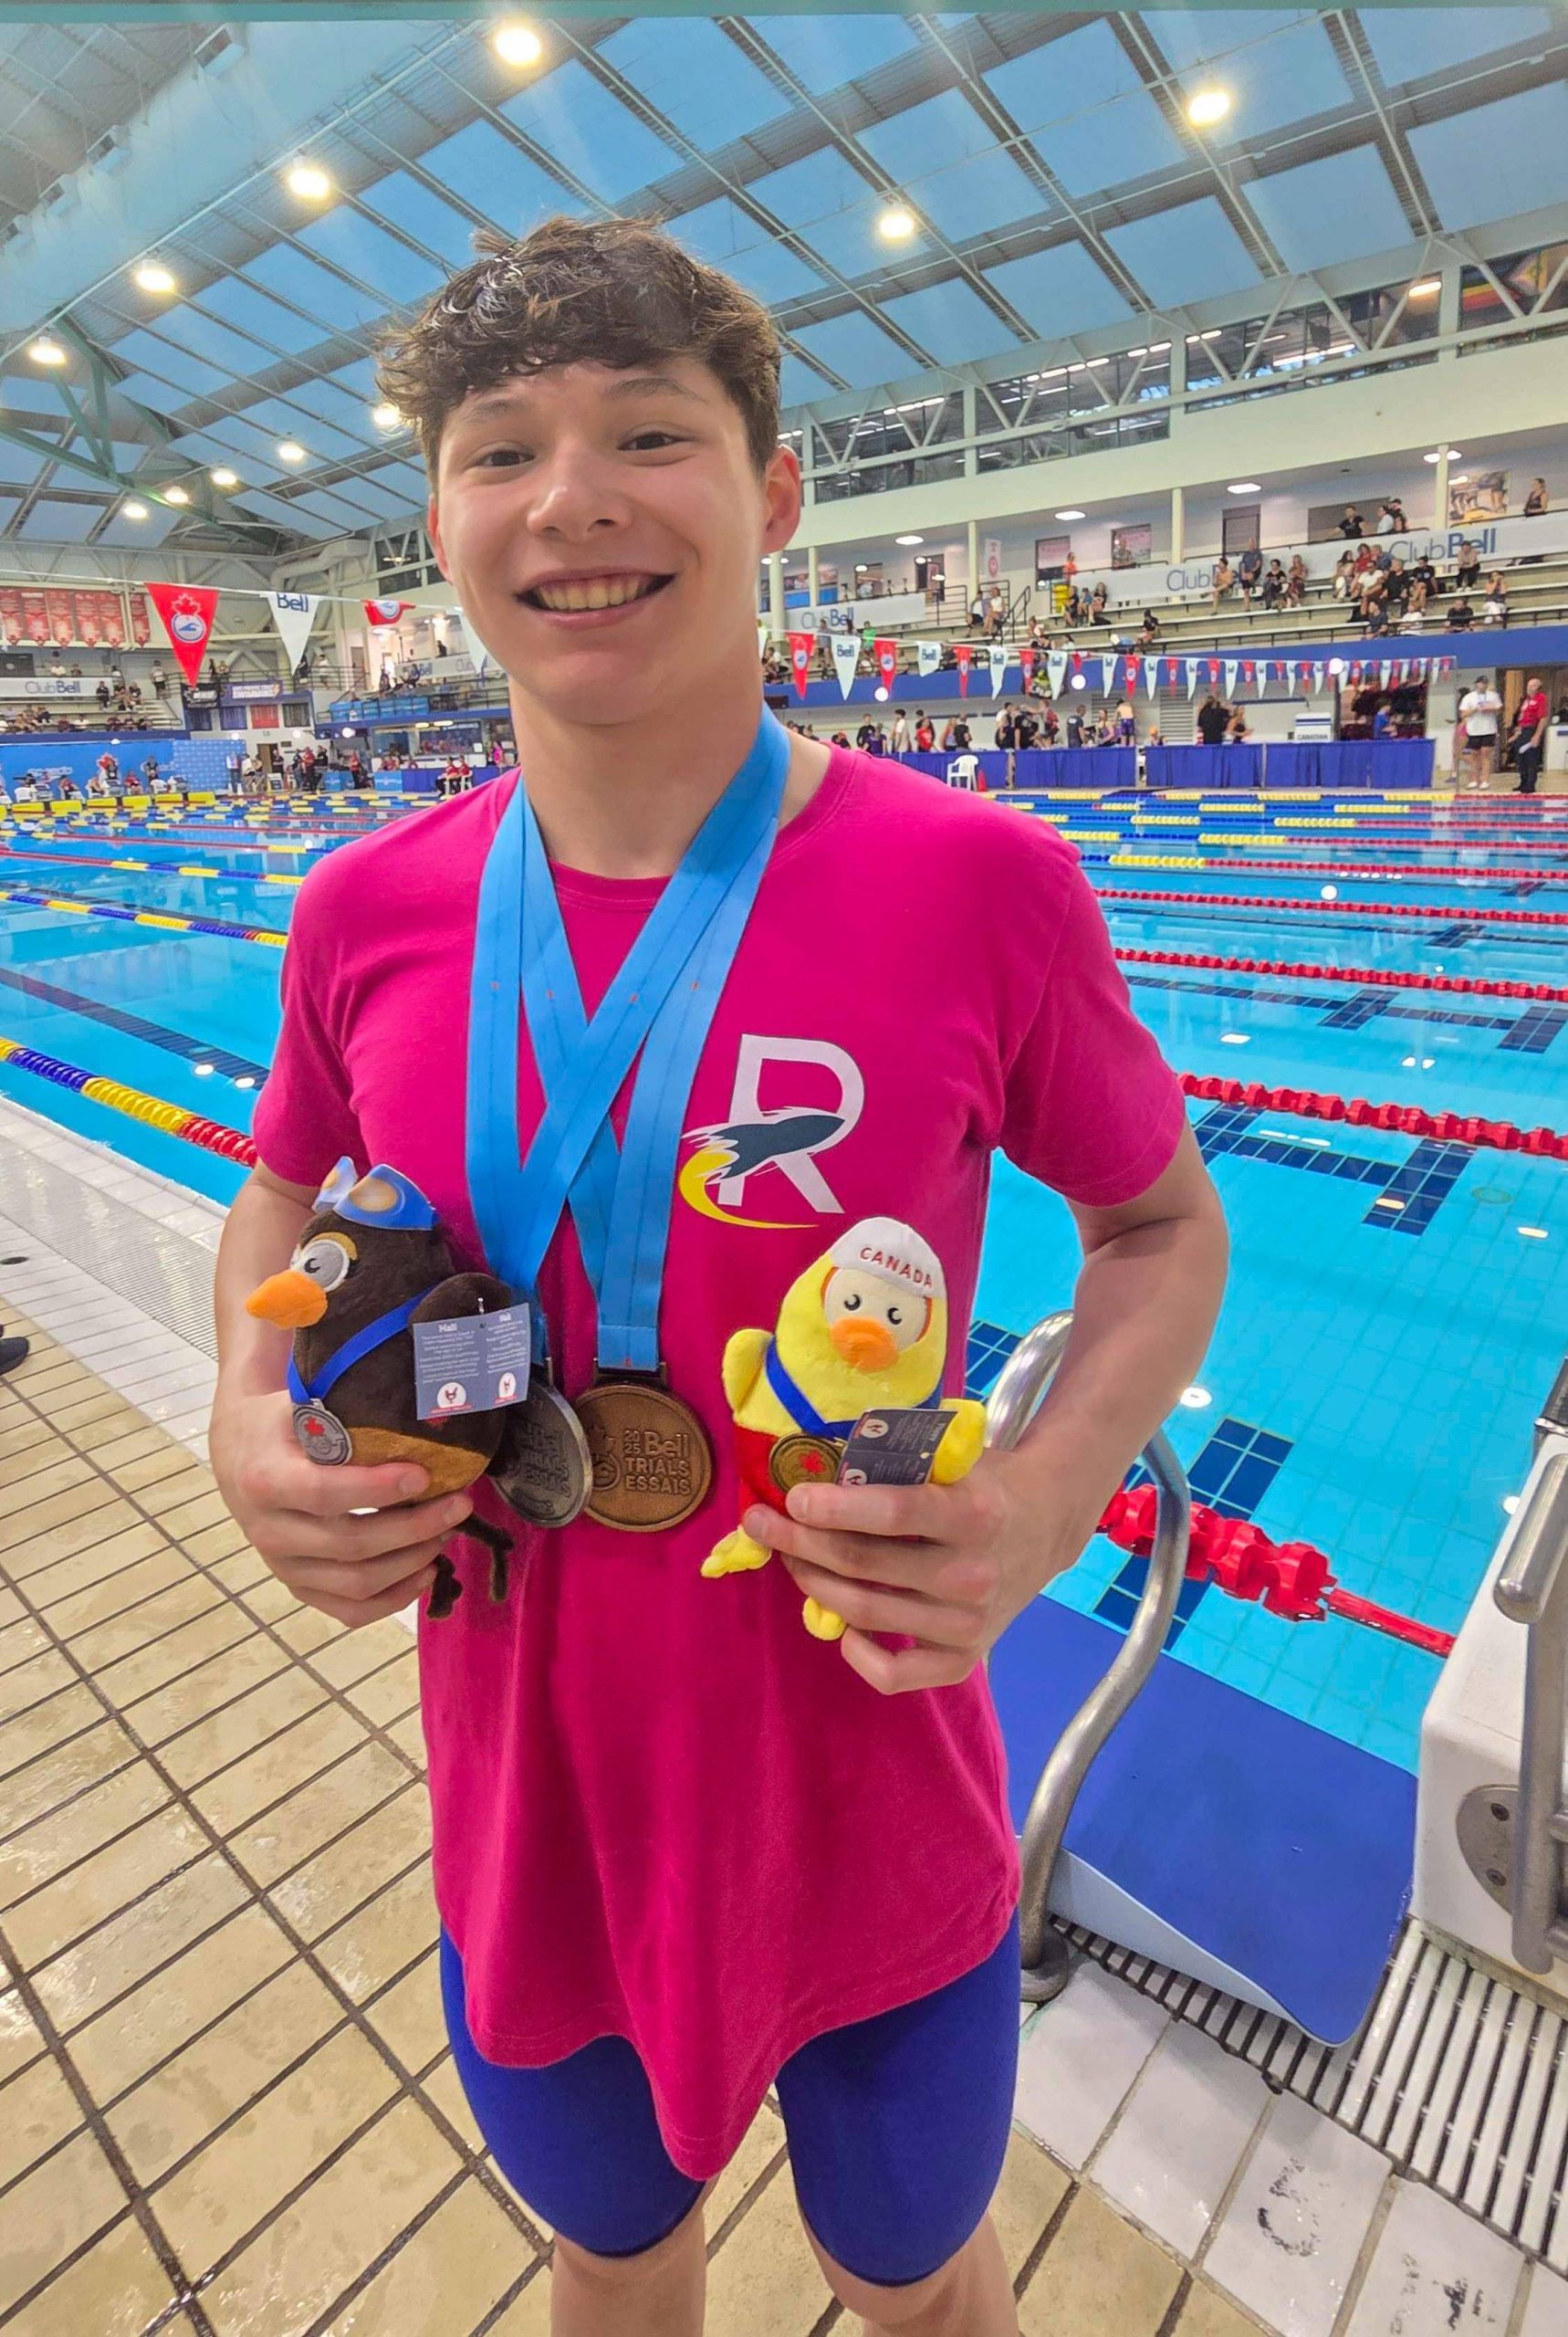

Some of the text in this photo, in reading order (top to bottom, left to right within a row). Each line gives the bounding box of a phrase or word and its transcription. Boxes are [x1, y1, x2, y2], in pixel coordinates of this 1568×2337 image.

[277, 593, 309, 613] Bell
[837, 645, 855, 658] Bell
[860, 1247, 933, 1289] CANADA
[624, 1430, 692, 1458] 20 Bell
[624, 1442, 642, 1454] 25
[624, 1457, 691, 1477] TRIALS
[624, 1474, 692, 1496] ESSAIS
